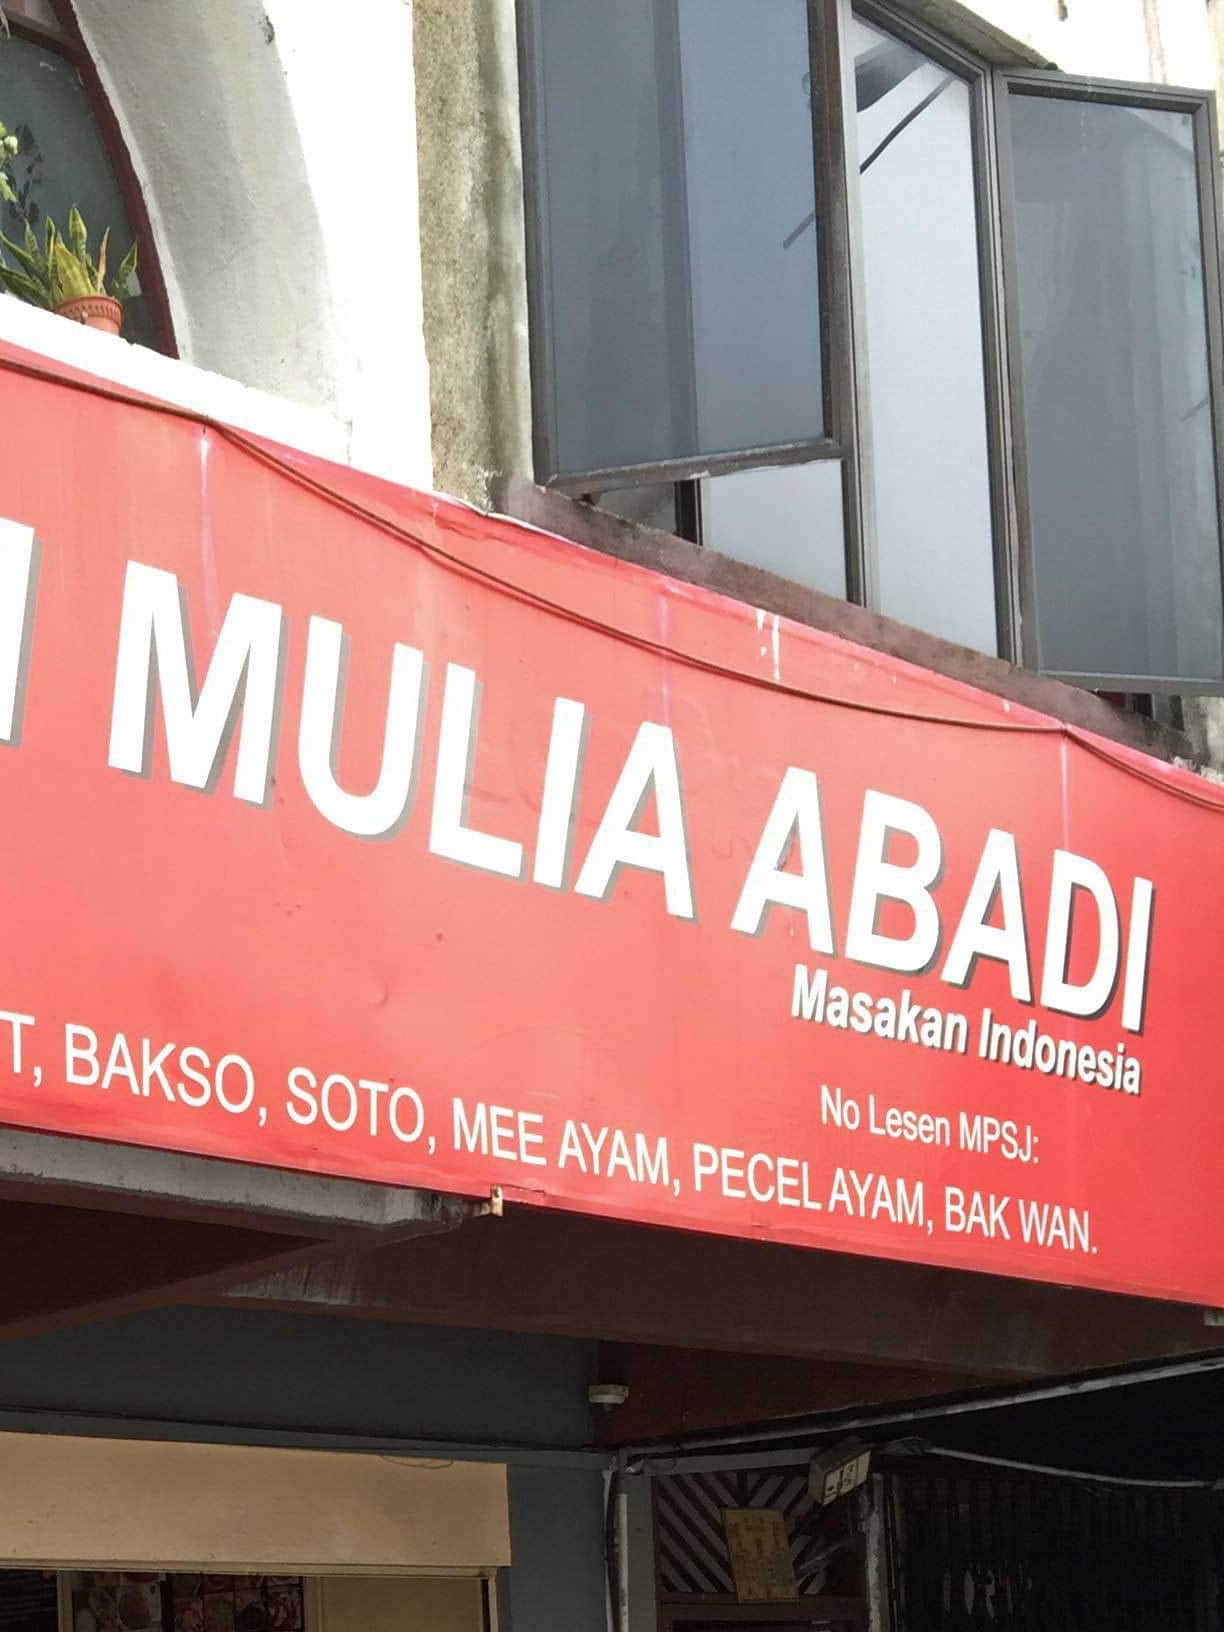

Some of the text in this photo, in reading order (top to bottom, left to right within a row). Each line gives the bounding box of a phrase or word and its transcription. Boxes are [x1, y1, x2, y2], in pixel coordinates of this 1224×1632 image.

[107, 560, 697, 922] MULIA
[729, 766, 1154, 1034] ABADI
[791, 963, 1142, 1096] Masakan Indonesia
[65, 1023, 268, 1127] BAKSO,
[286, 1066, 436, 1156] SOTO,
[452, 1097, 547, 1166] MEE
[557, 1119, 681, 1196] AYAM,
[693, 1142, 822, 1210] PECEL
[828, 1167, 934, 1232] AYAM,
[945, 1186, 1010, 1240] BAK
[1018, 1199, 1098, 1254] WAN.
[821, 1085, 1040, 1165] No Lesen MPSJ:
